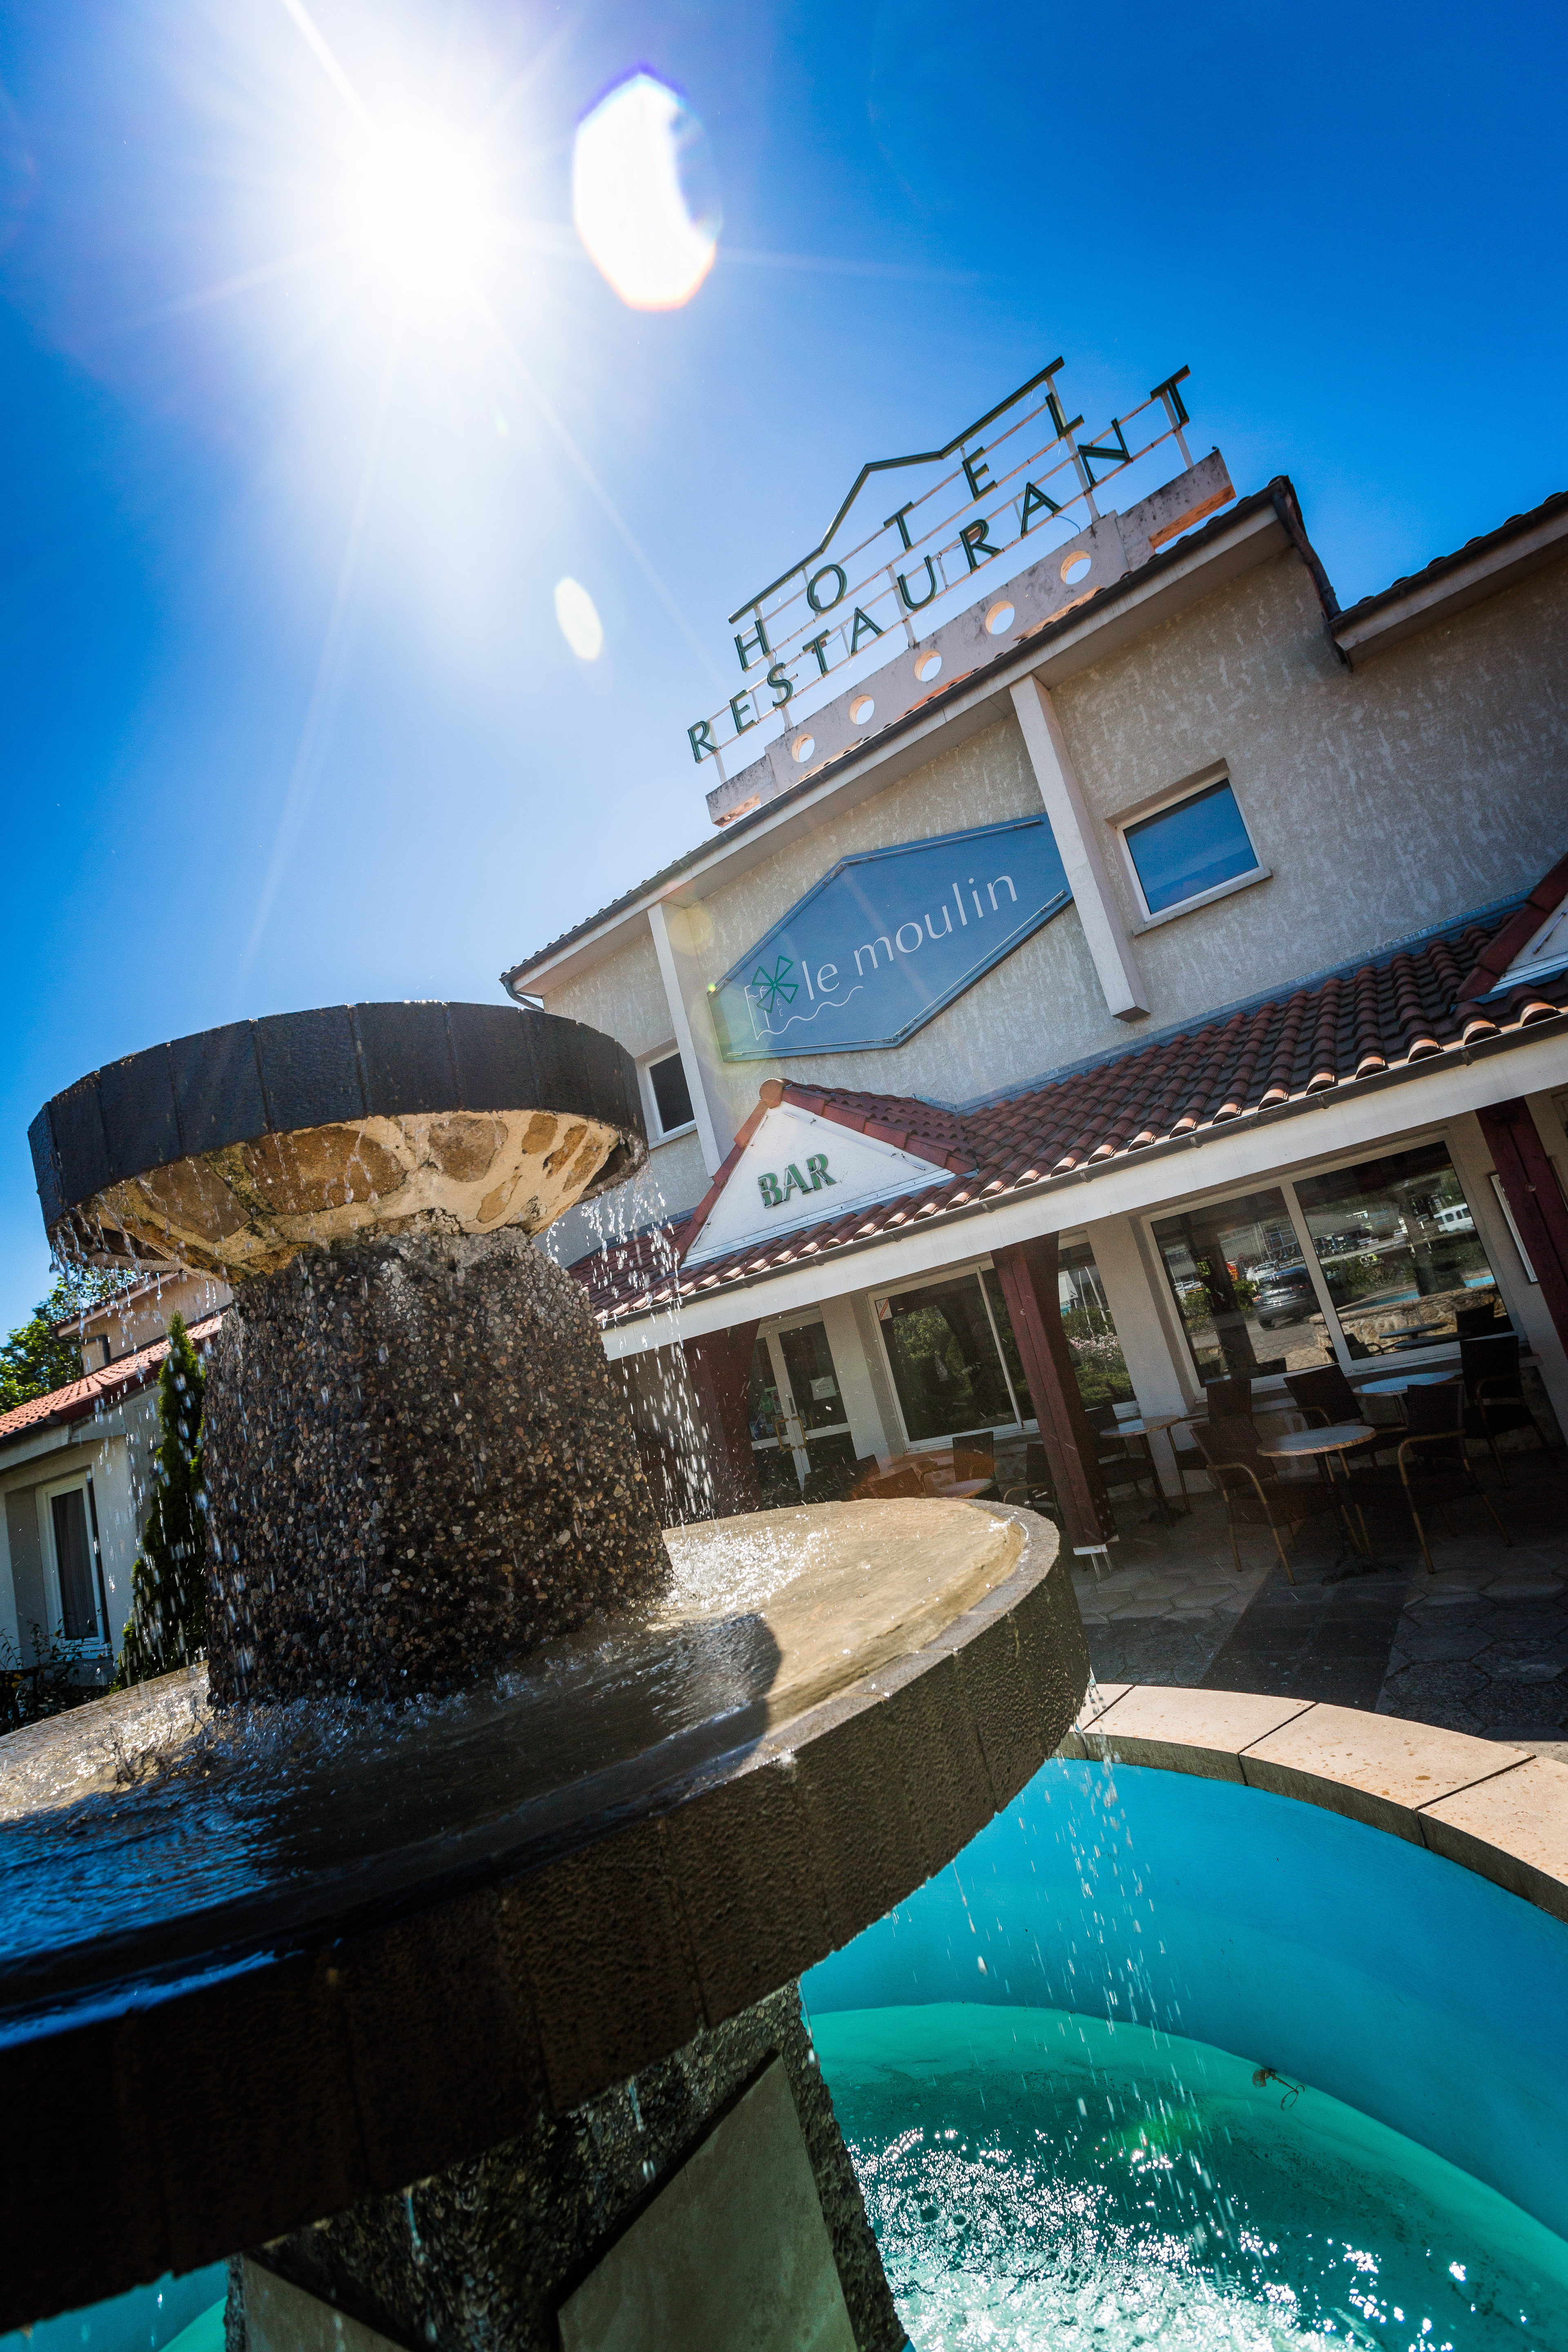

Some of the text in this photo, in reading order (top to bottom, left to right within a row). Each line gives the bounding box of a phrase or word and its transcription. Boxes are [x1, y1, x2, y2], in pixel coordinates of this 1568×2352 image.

[687, 364, 1191, 763] RESTAURANT
[734, 392, 1085, 672] HOTEL
[802, 875, 1018, 1000] le moulin
[757, 1154, 837, 1209] BAR
